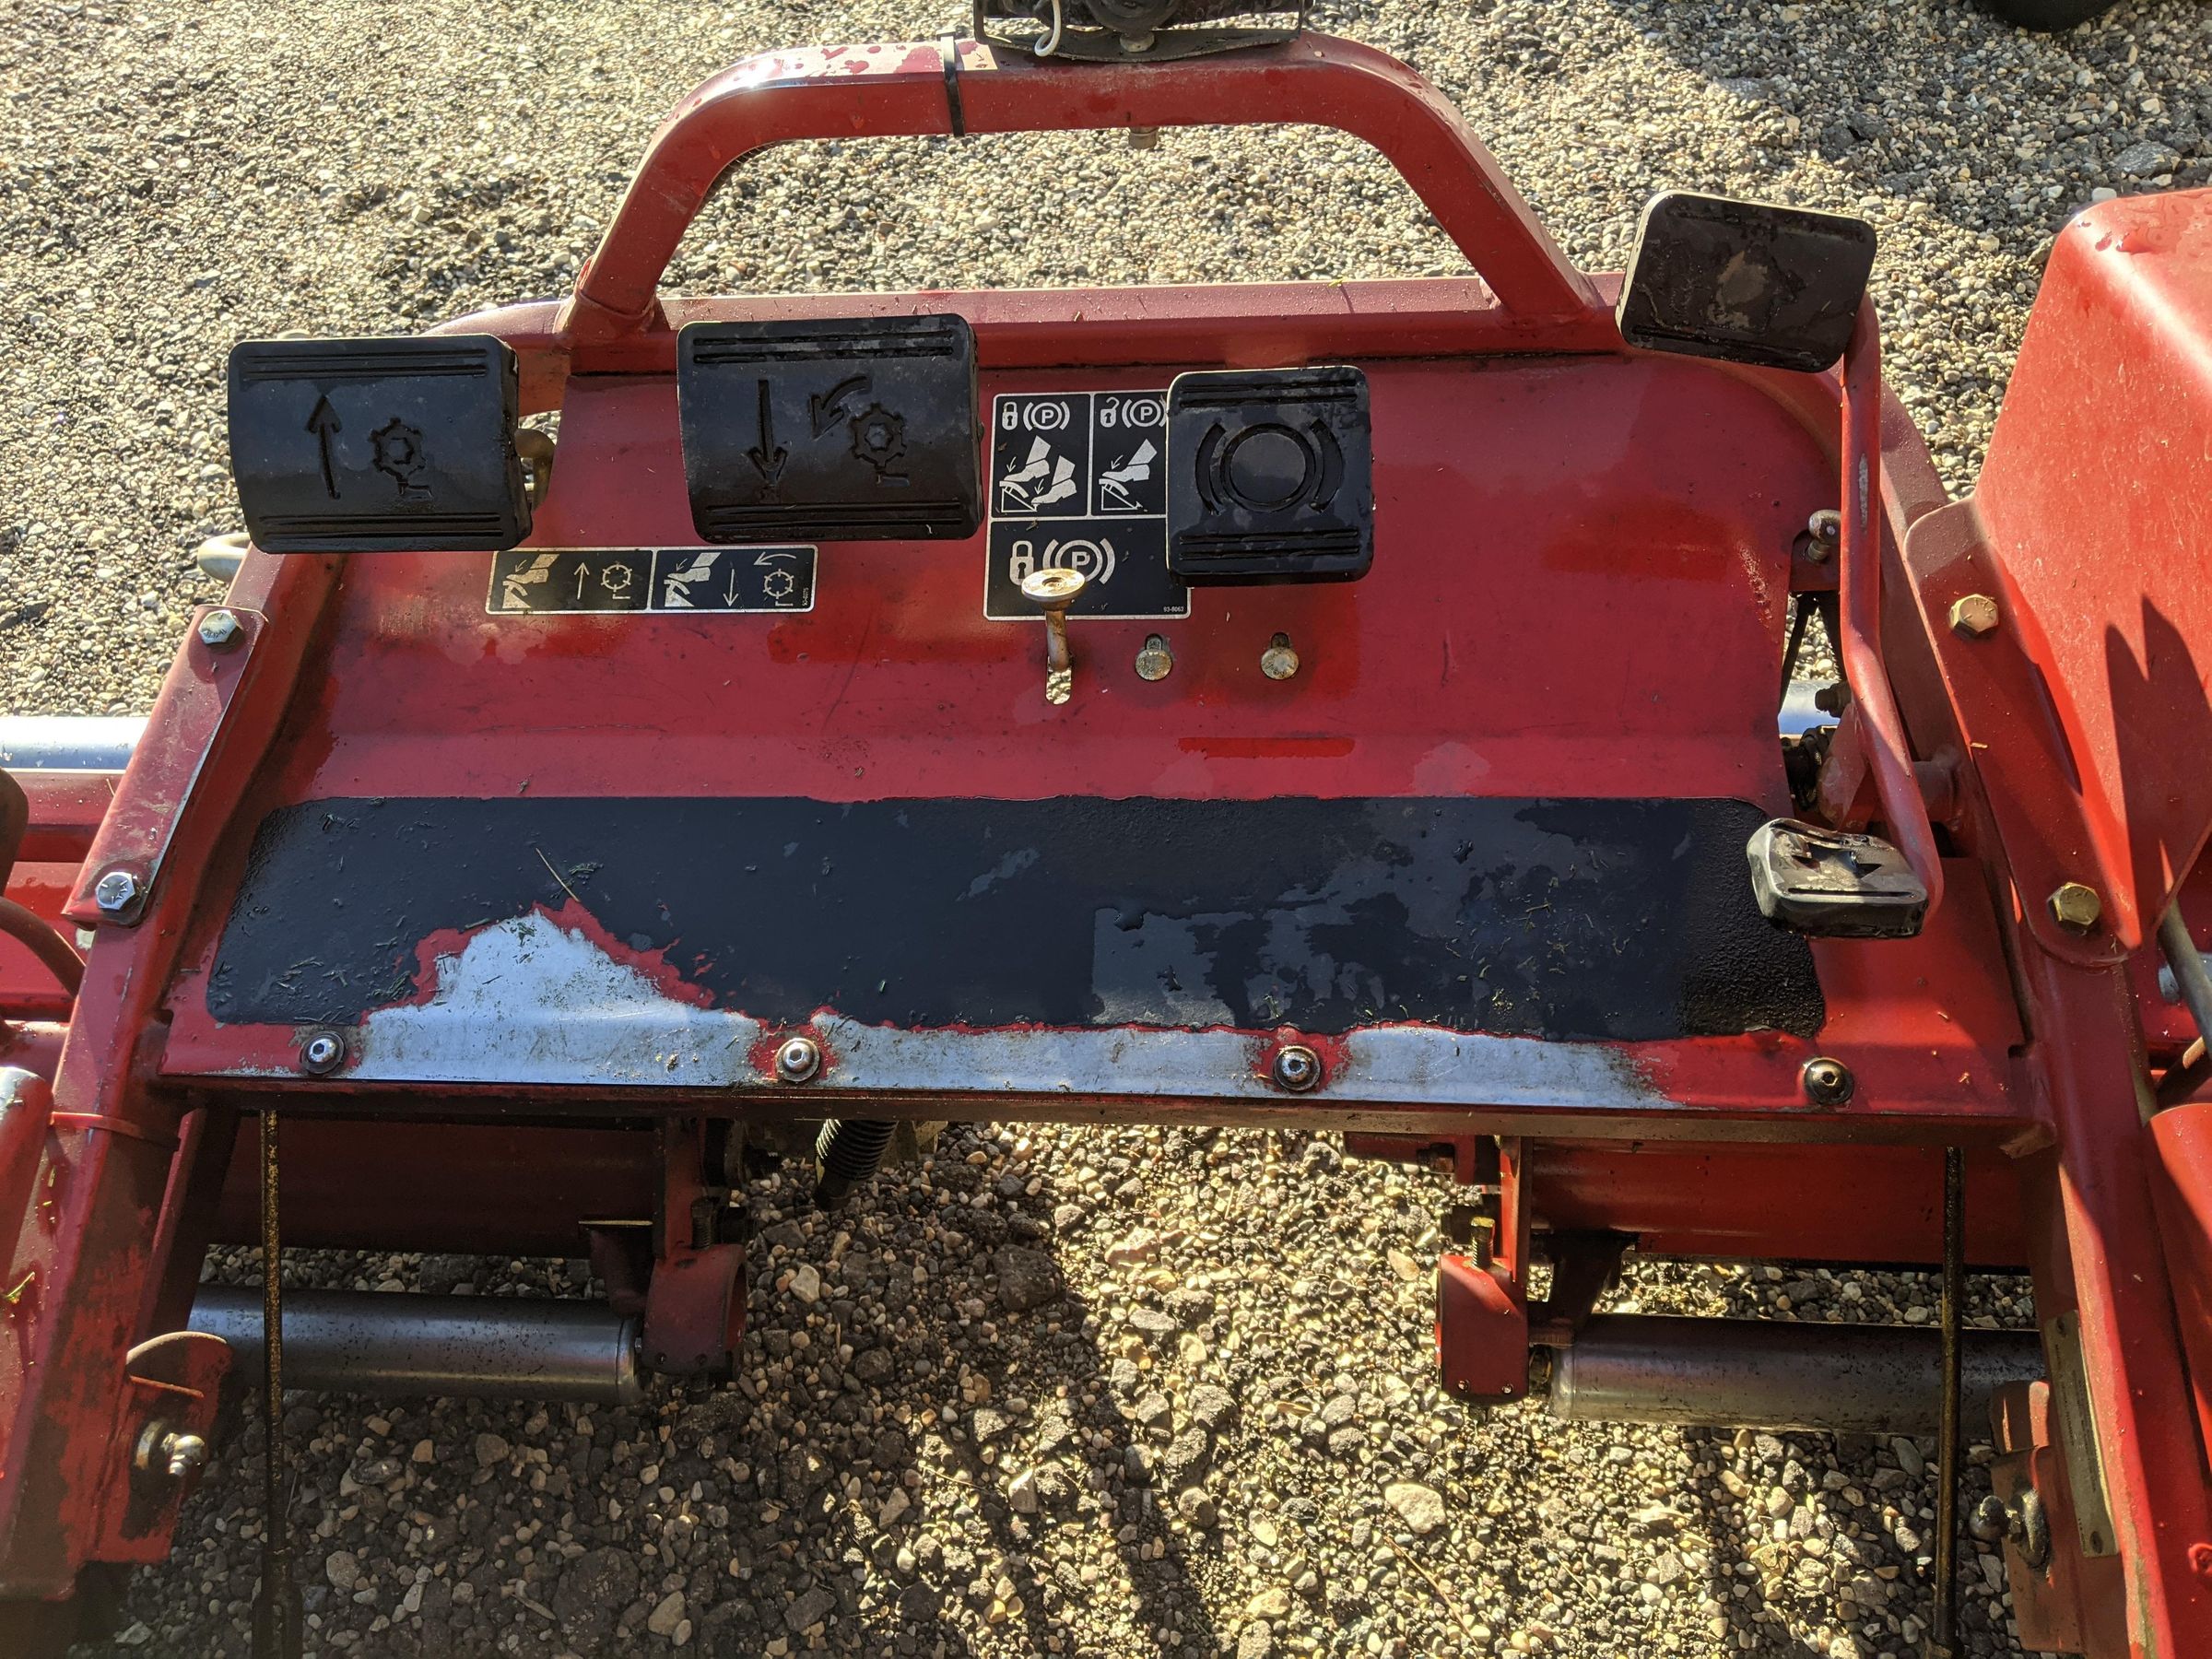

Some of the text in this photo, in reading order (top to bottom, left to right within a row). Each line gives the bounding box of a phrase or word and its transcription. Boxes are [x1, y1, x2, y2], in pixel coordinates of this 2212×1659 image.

[1041, 409, 1054, 424] P
[1140, 406, 1153, 420] P
[1071, 551, 1090, 571] P
